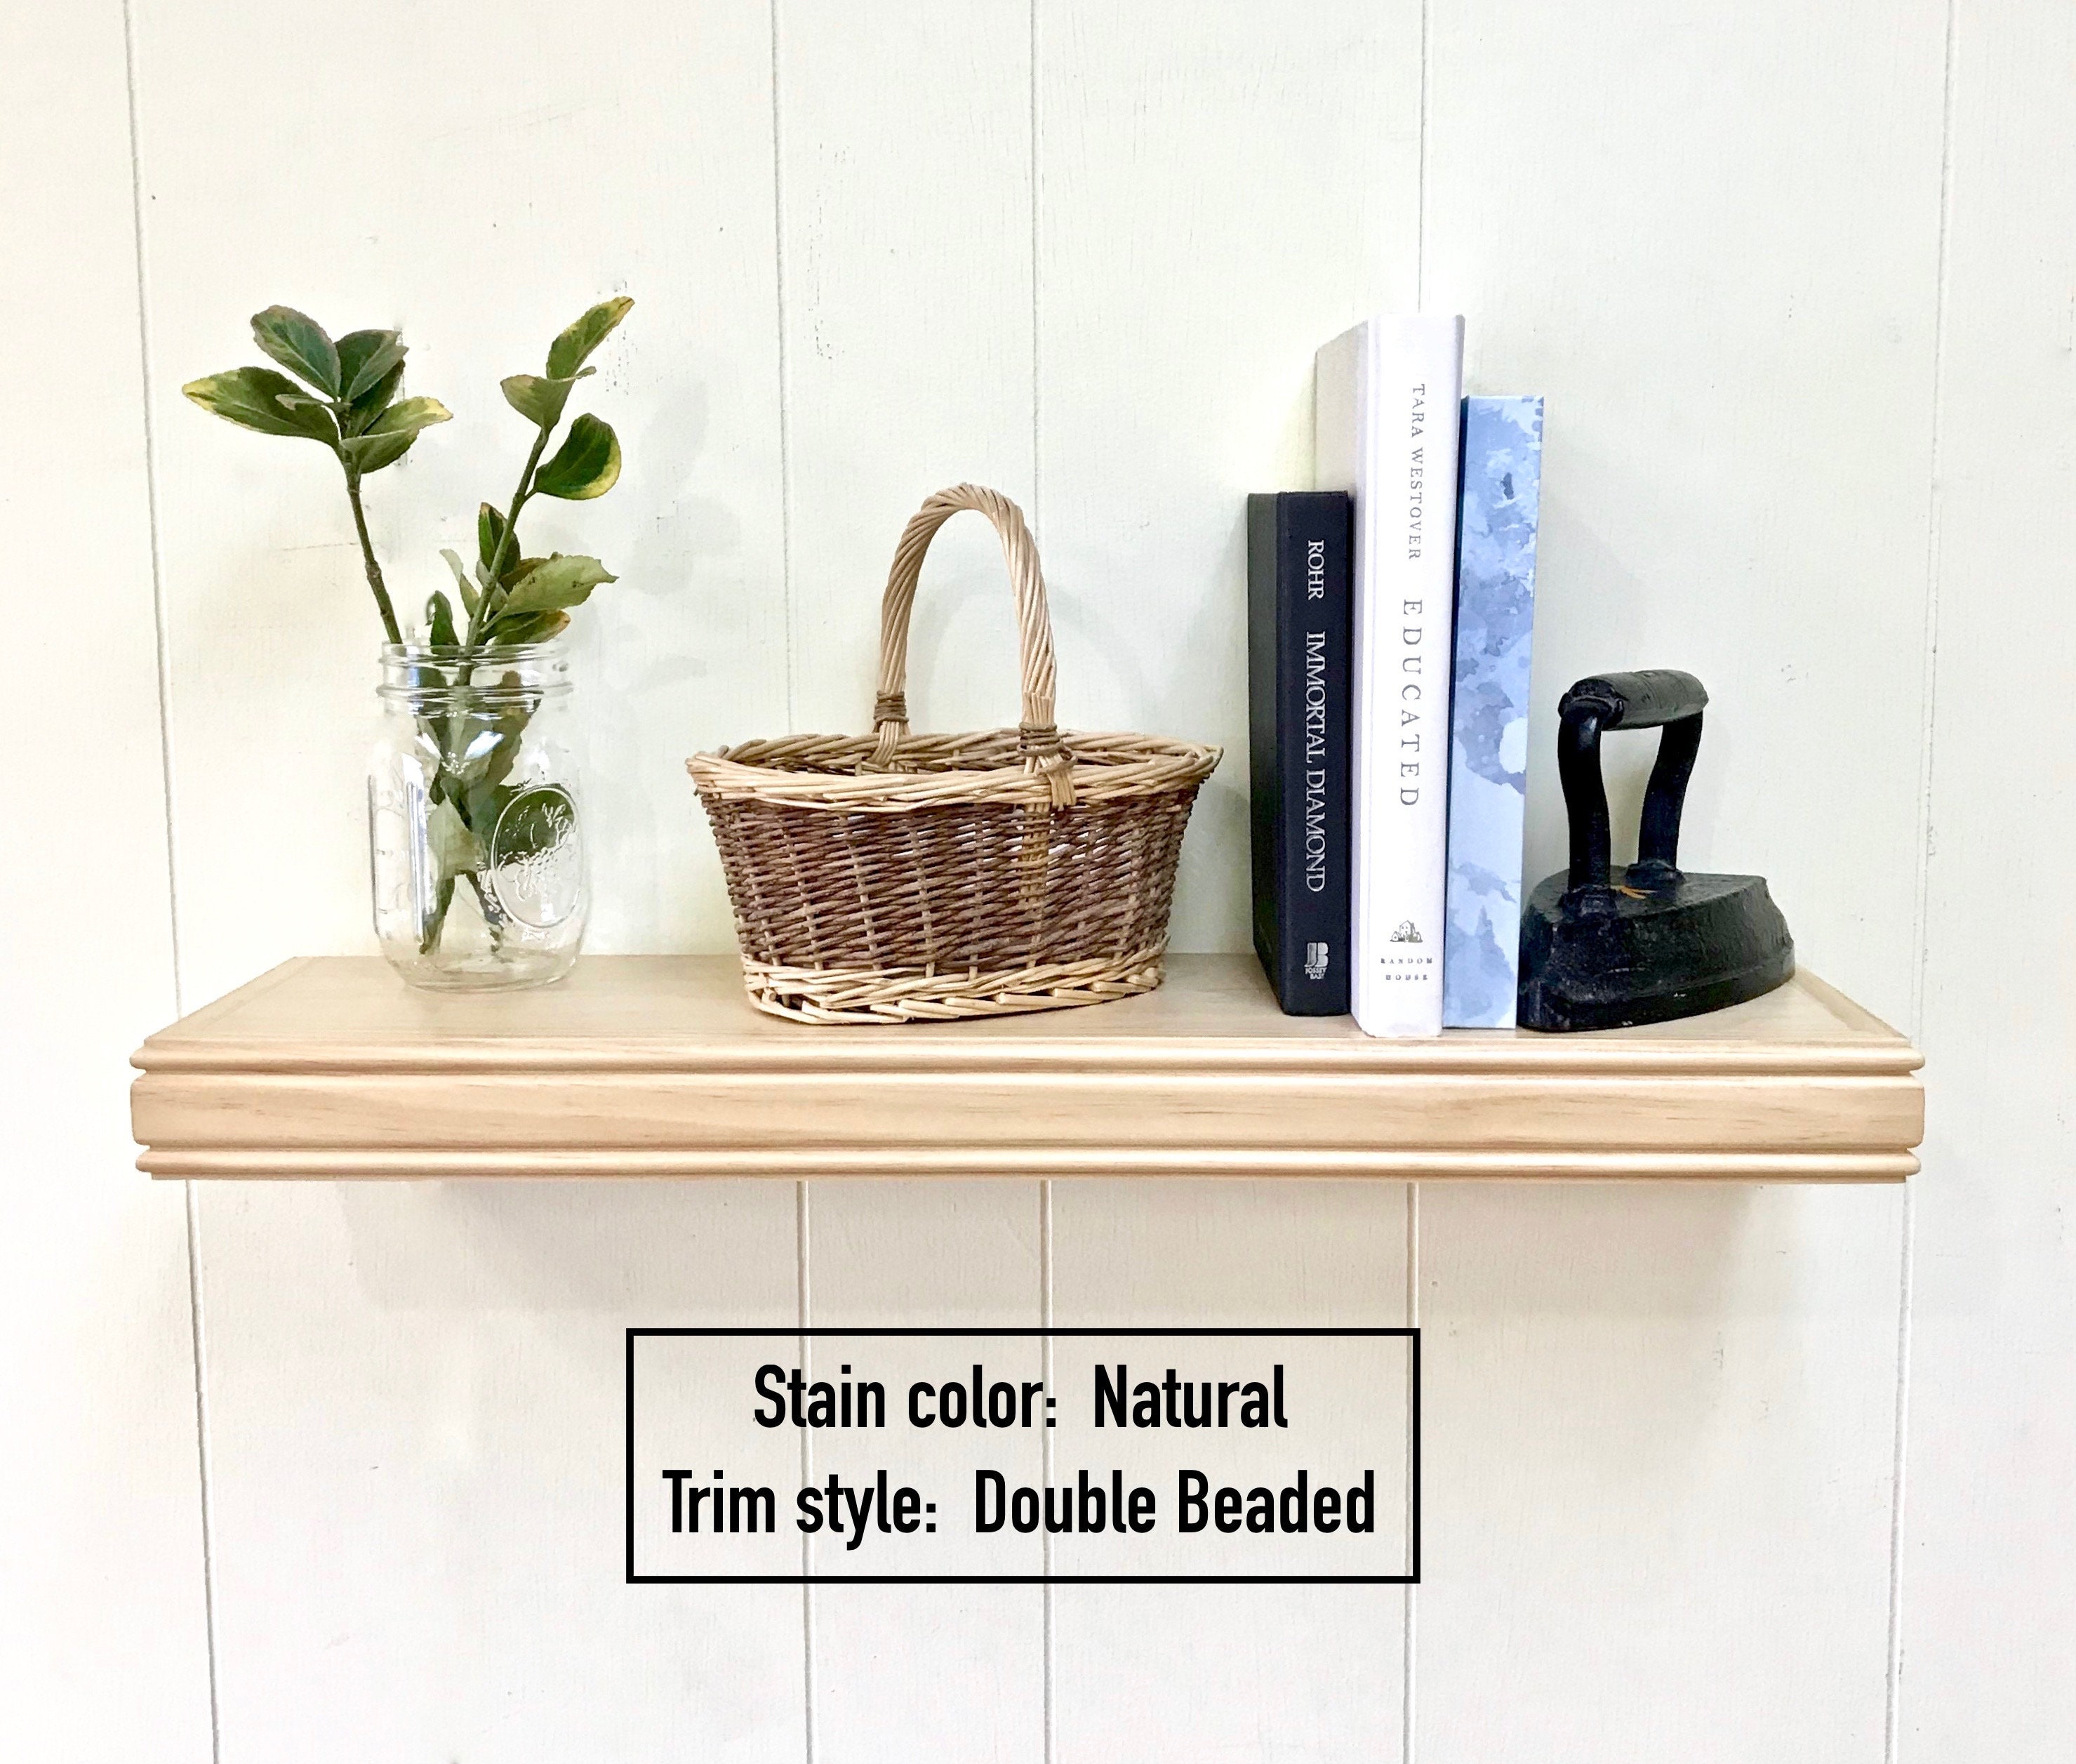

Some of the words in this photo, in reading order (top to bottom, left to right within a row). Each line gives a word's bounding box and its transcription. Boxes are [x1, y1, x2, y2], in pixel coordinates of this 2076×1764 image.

[1411, 383, 1425, 438] TARA
[1409, 446, 1423, 559] WESTOVER
[1307, 539, 1325, 600] ROHR
[1306, 630, 1326, 764] IMMORTAL
[1399, 599, 1423, 807] EDUCATED
[1305, 768, 1326, 892] DIAMOND
